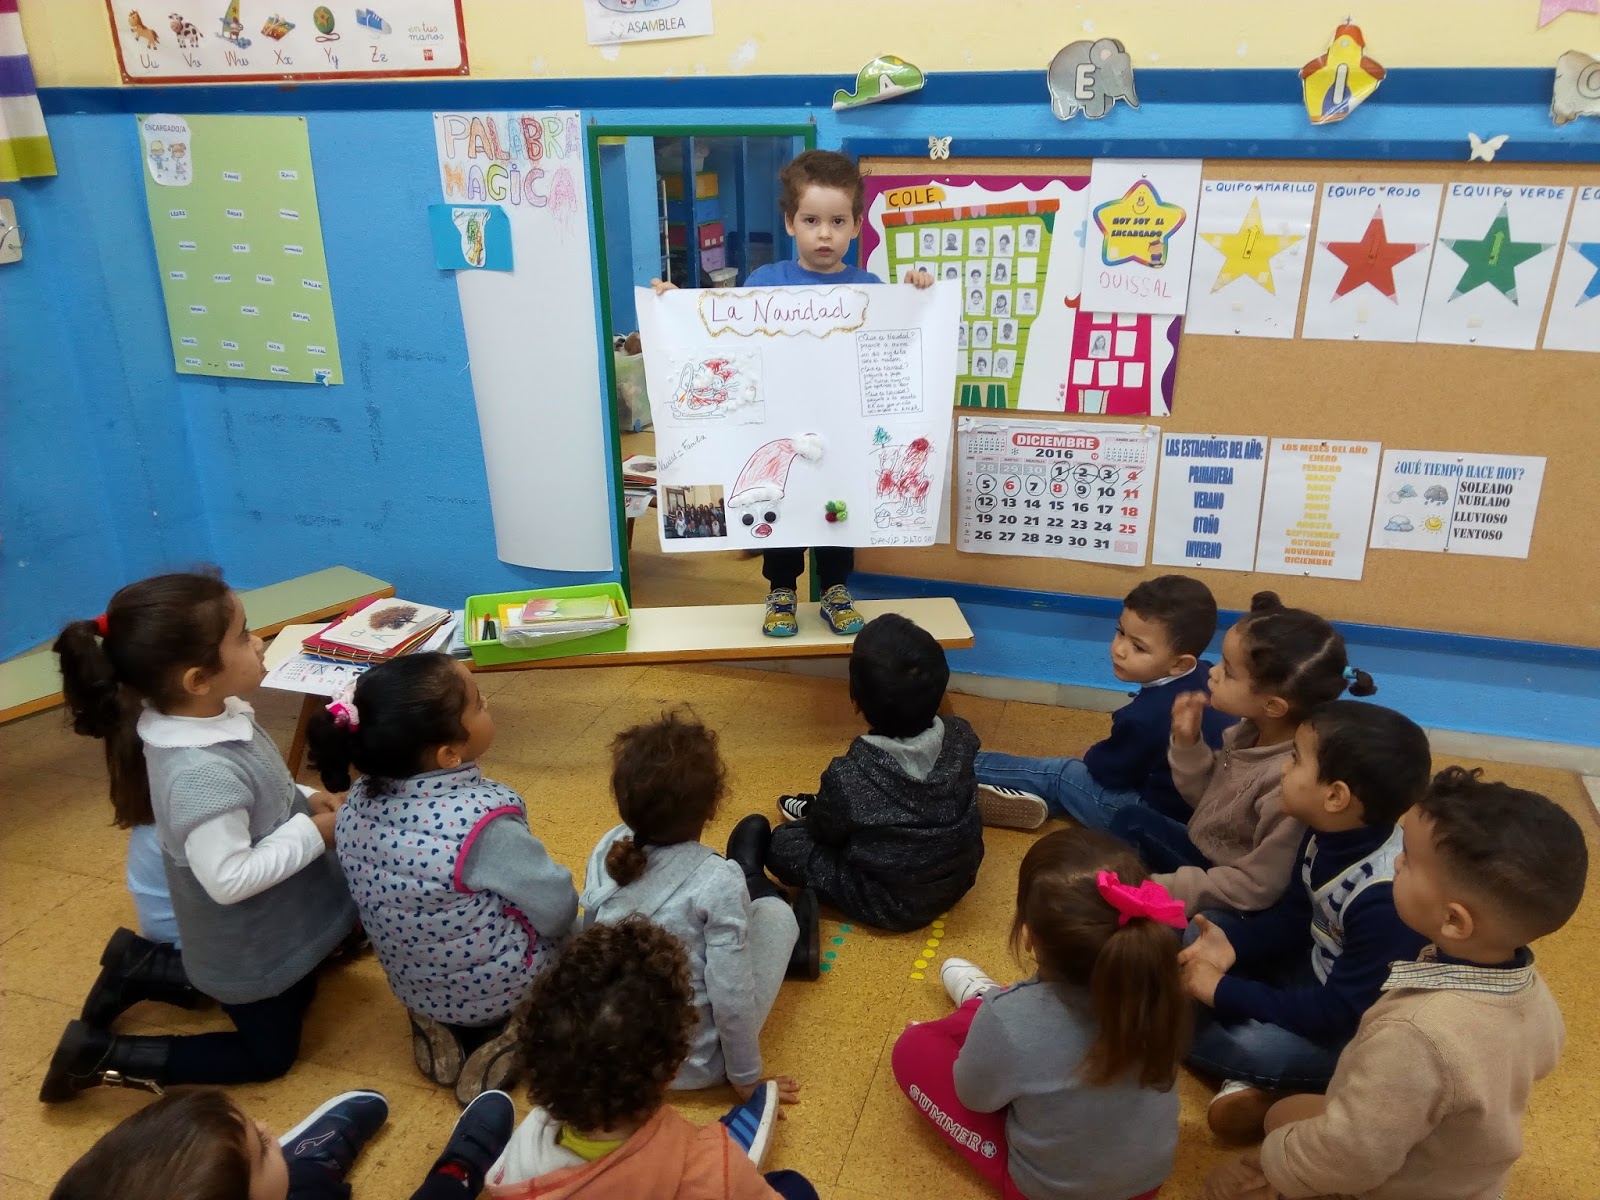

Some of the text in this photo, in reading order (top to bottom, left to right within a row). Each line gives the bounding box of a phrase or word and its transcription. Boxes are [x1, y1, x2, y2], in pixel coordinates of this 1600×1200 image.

[422, 21, 438, 33] tus
[627, 17, 686, 34] ASAMBLEA
[408, 33, 444, 41] manos
[879, 74, 897, 93] A
[1075, 63, 1096, 99] E
[145, 123, 187, 134] ENCARGADO/A
[443, 114, 580, 161] PALABRA
[1255, 183, 1315, 193] AMARILLO
[1328, 185, 1421, 198] EQUIPO ROJO
[1520, 187, 1566, 199] VERDE
[888, 188, 936, 207] COLE
[1112, 217, 1165, 226] HOY SOY EL
[1111, 230, 1163, 238] ENCARGADO
[1099, 271, 1172, 298] OUISSAL
[712, 295, 851, 324] La Navidad
[1016, 435, 1095, 449] DICIEMBRE
[1165, 438, 1180, 457] LAS
[1181, 439, 1228, 459] ESTACIONES
[1229, 440, 1243, 459] DEL
[1281, 443, 1369, 454] LOS MESES DEL AÑO
[1035, 448, 1074, 459] 2016
[1309, 454, 1337, 462] ENERO
[980, 463, 995, 471] 28
[1003, 465, 1019, 473] 29
[1055, 466, 1064, 475] 1
[1079, 468, 1088, 477] 2
[1103, 469, 1113, 480] 3
[1127, 471, 1138, 480] 4
[1188, 465, 1234, 485] PRIMAVERA
[1394, 459, 1525, 480] ¿QUÉ TIEMPO HACE HOY?
[982, 479, 1139, 499] 5 6 7 8 9 10 11
[1459, 481, 1513, 495] SOLEADO
[977, 496, 1139, 517] 12 13 14 15 16 17 18
[1194, 491, 1225, 510] VERANO
[1457, 494, 1510, 508] NUBLADO
[976, 513, 1137, 534] 19 20 21 22 23 24 25
[1192, 514, 1220, 534] OTOÑO
[1454, 511, 1508, 524] LLUVIOSO
[974, 530, 993, 540] 26
[998, 531, 1016, 541] 27
[1021, 532, 1040, 543] 28
[1045, 534, 1064, 545] 29
[1068, 536, 1088, 547] 30
[1093, 538, 1110, 549] 31
[1453, 527, 1503, 540] VENTOSO
[1185, 540, 1222, 559] INVIERNO
[1284, 547, 1336, 557] NOVIEMBRE
[1284, 556, 1333, 566] DICIEMBRE
[909, 1084, 982, 1152] SUMMER
